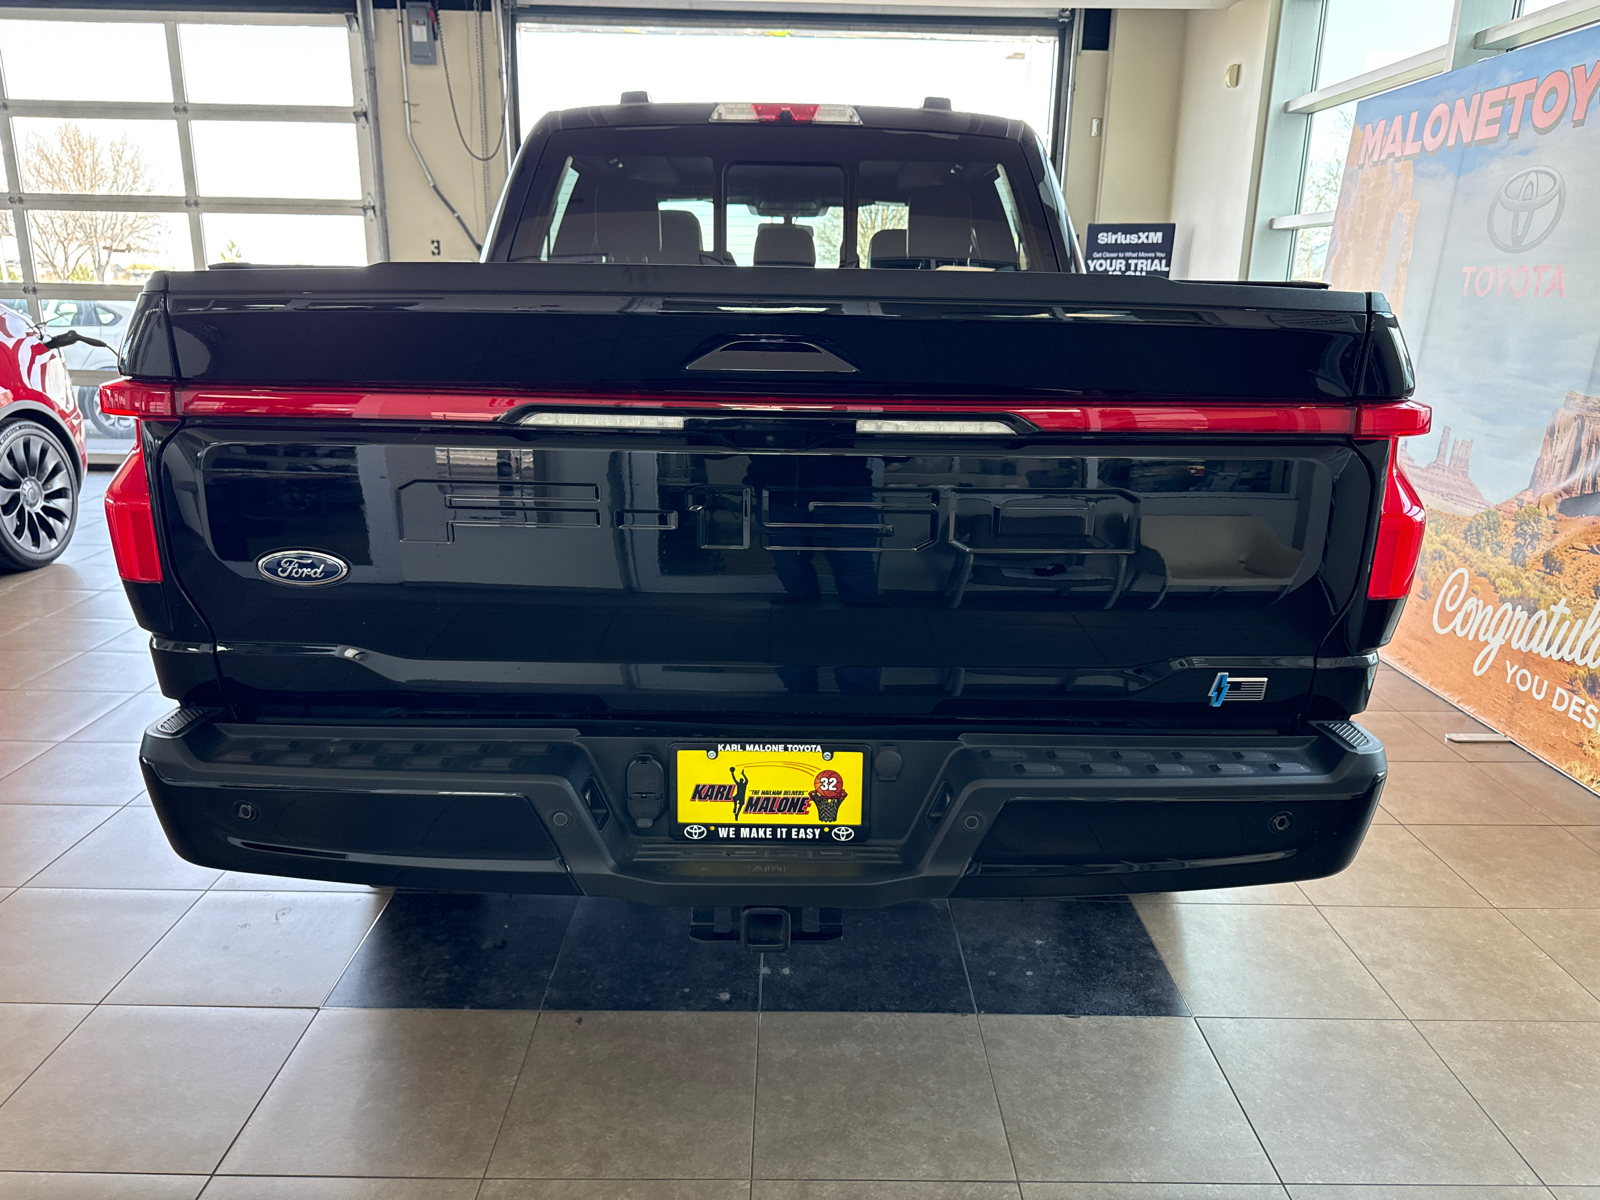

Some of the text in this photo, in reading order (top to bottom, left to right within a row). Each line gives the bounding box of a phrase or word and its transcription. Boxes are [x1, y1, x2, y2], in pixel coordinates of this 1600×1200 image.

[1357, 60, 1600, 169] MALONETOY
[1097, 231, 1163, 244] SiriusXM
[431, 239, 441, 256] 3
[1087, 259, 1170, 271] YOUR TRIAL
[1461, 264, 1567, 298] TOYOTA
[395, 478, 1141, 555] F-150
[277, 558, 325, 578] Ford
[1505, 660, 1600, 734] YOU DES
[717, 743, 823, 753] KARL MALONE TOYOTA
[690, 783, 736, 802] KARL
[820, 777, 837, 791] 32
[743, 796, 811, 815] MALONE
[718, 827, 821, 839] WE MAKE IT EASY
